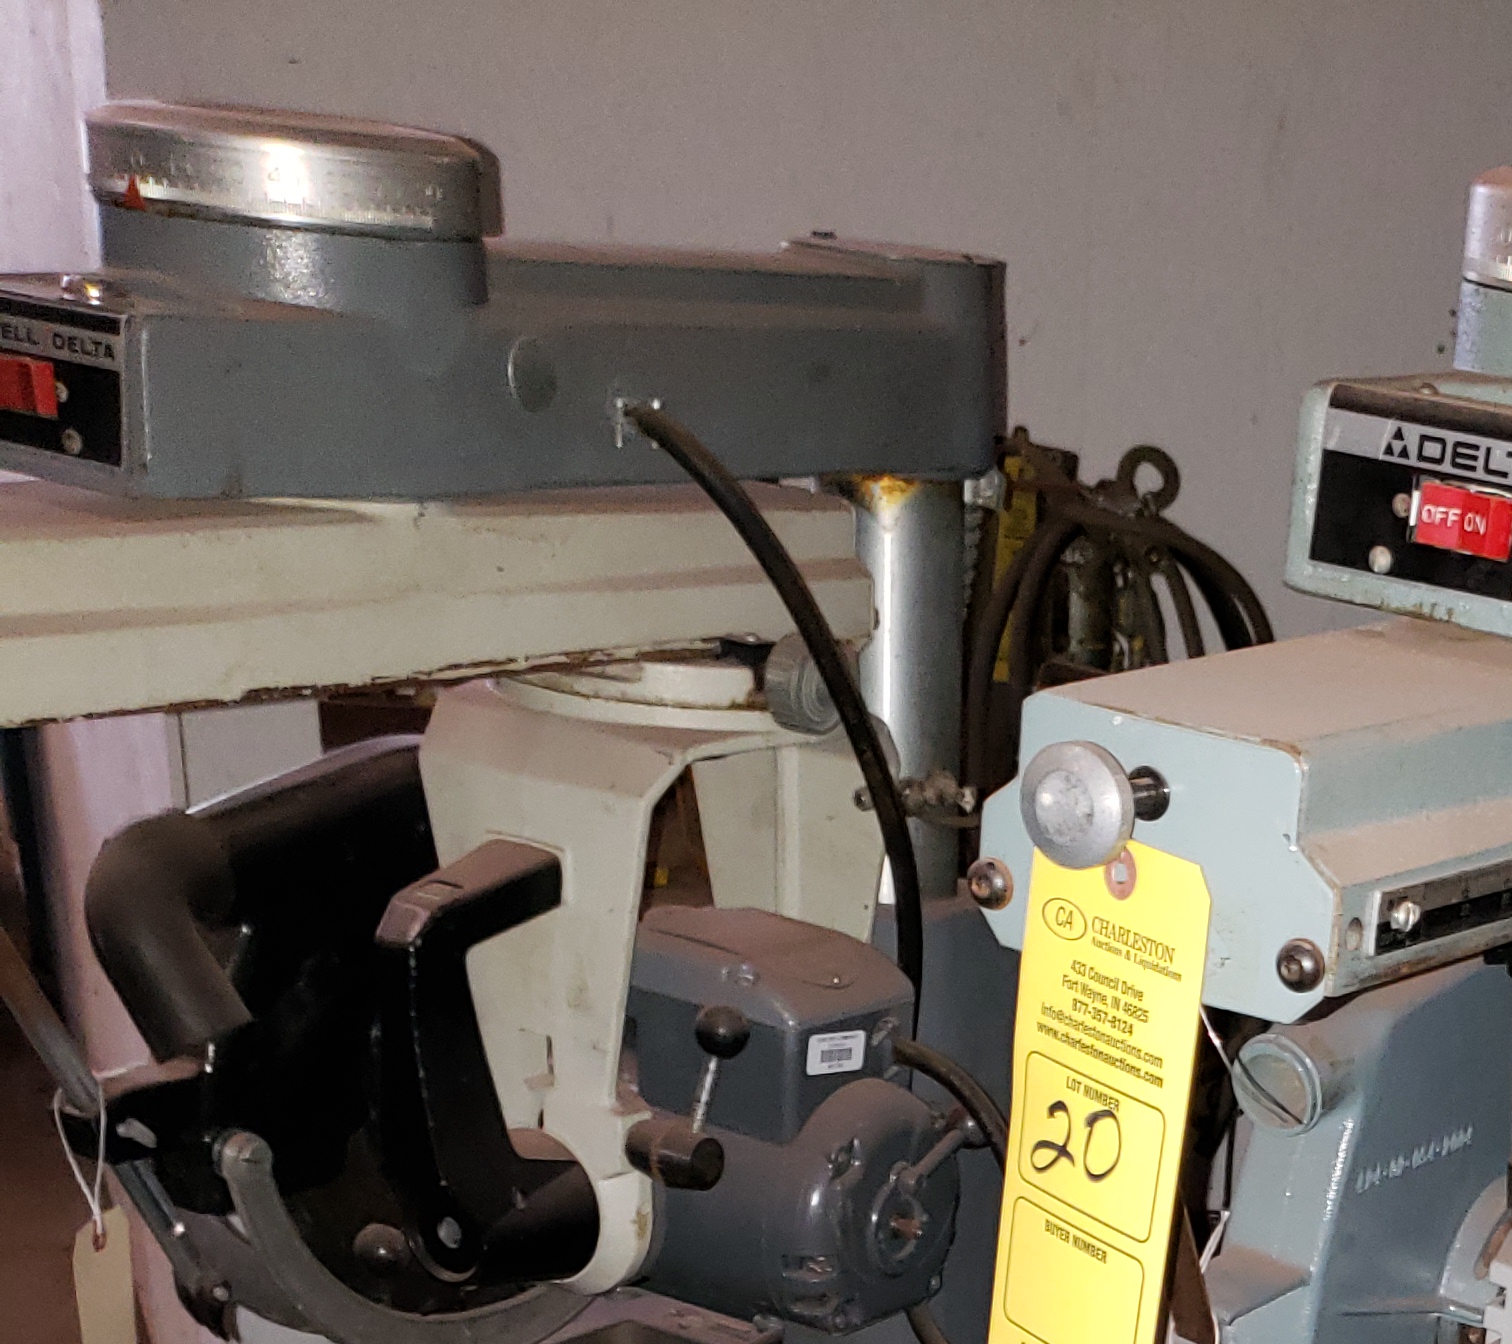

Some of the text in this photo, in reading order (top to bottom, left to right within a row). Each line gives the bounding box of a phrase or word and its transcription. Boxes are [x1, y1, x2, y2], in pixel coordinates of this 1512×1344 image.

[53, 331, 116, 362] DELTA
[1421, 504, 1487, 535] OFF ON
[1055, 905, 1073, 931] CA
[1091, 915, 1176, 965] CHARLESTON
[1070, 959, 1144, 1002] 433 Council Drive
[1091, 936, 1183, 983] Auctions & Liquidations
[1062, 974, 1150, 1024] Fort Wayne, IN 46825
[1071, 998, 1134, 1037] 877-357-8124
[1036, 1021, 1164, 1090] www.charlestonauctions.com
[1065, 1075, 1120, 1113] LOT NUMBER
[1030, 1100, 1122, 1183] 20
[1044, 1218, 1108, 1265] BUYER NUMBER
